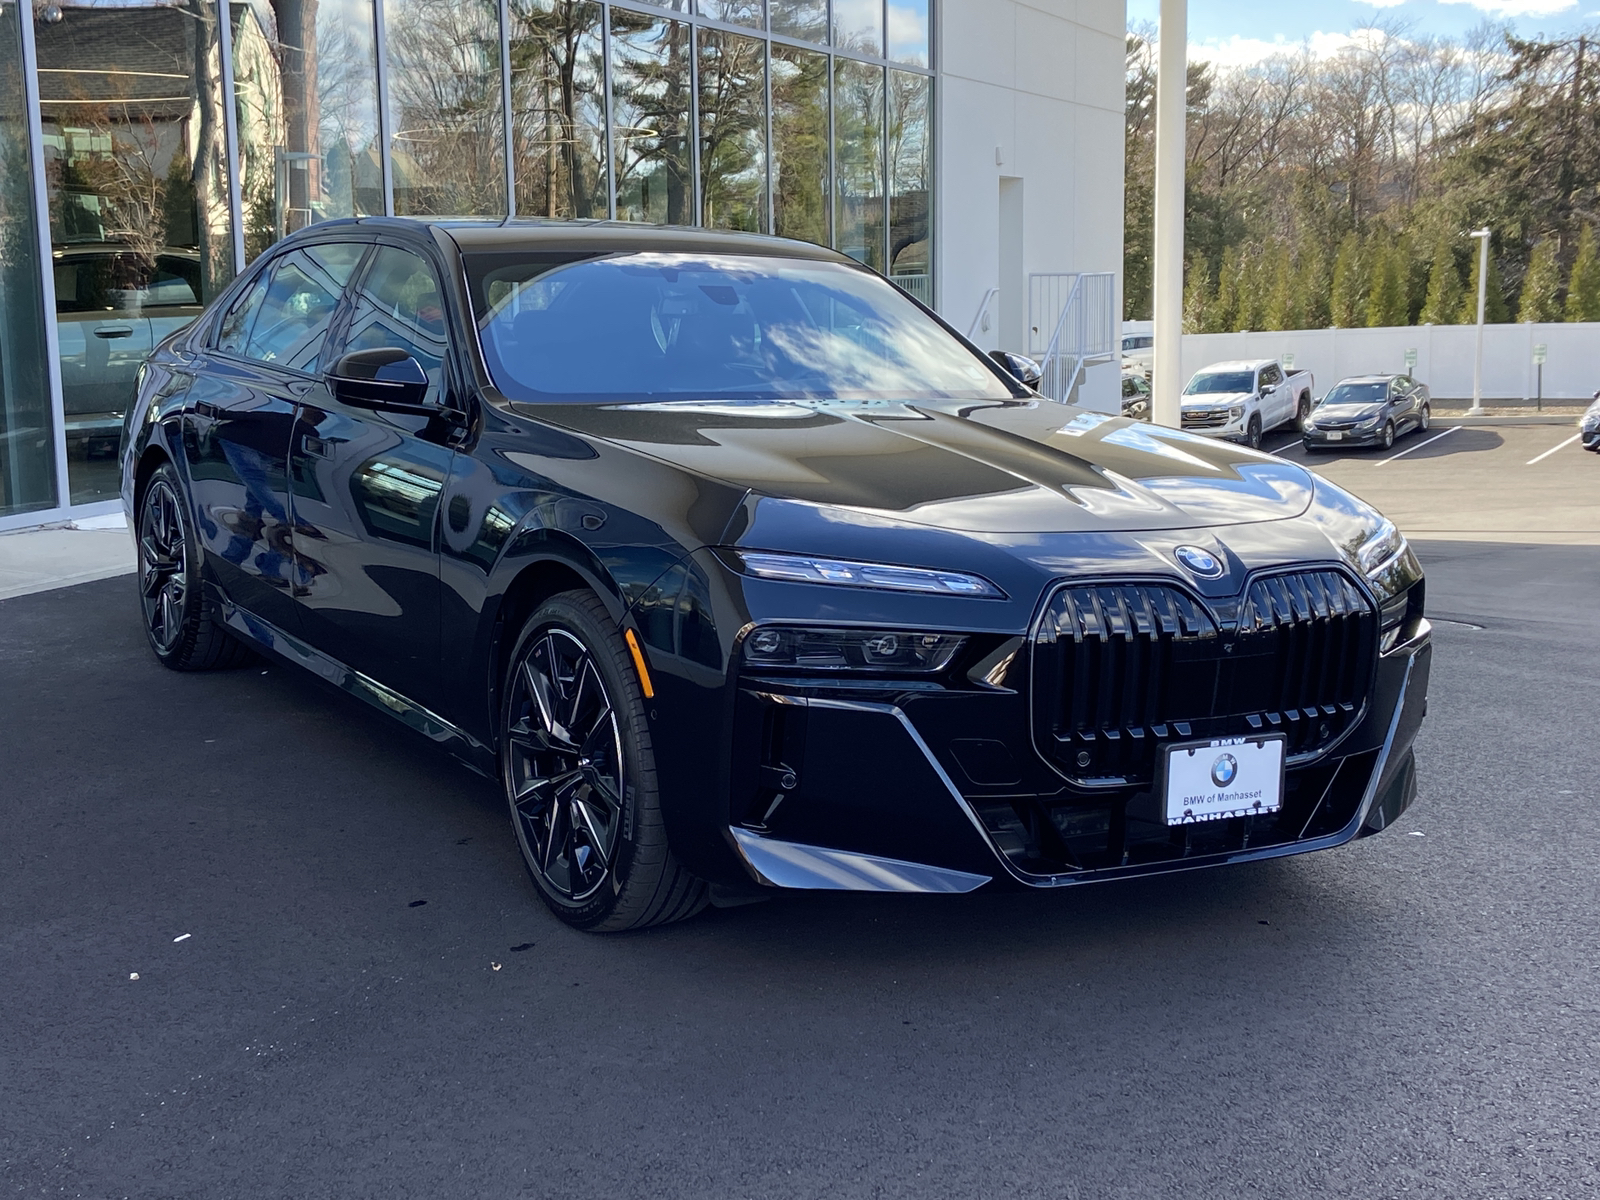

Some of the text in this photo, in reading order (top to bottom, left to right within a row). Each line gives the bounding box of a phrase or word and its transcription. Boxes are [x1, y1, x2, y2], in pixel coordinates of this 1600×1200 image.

[1210, 738, 1246, 747] BMW
[1183, 790, 1262, 806] BMW of Manhasset
[1167, 805, 1280, 826] MANHASSET
